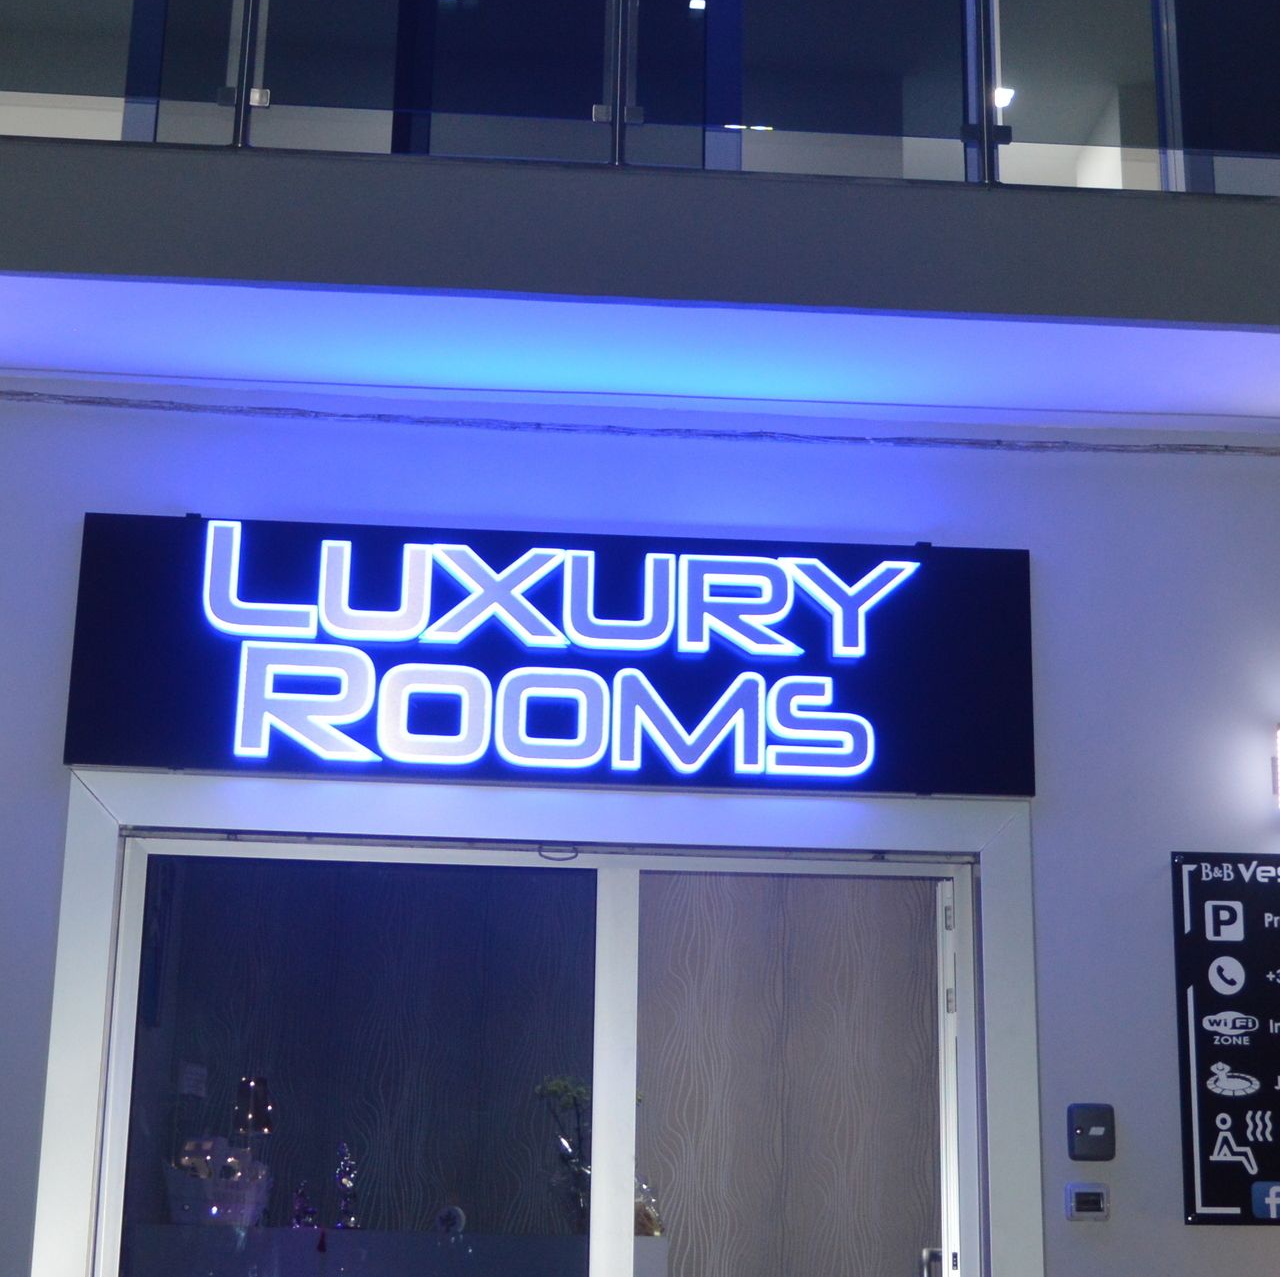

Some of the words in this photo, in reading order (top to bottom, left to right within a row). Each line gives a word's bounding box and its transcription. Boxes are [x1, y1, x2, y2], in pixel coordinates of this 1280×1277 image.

[202, 519, 920, 658] LUXURY
[232, 639, 875, 777] ROOMS
[1200, 862, 1234, 882] B&B
[1213, 1035, 1250, 1045] ZONE
